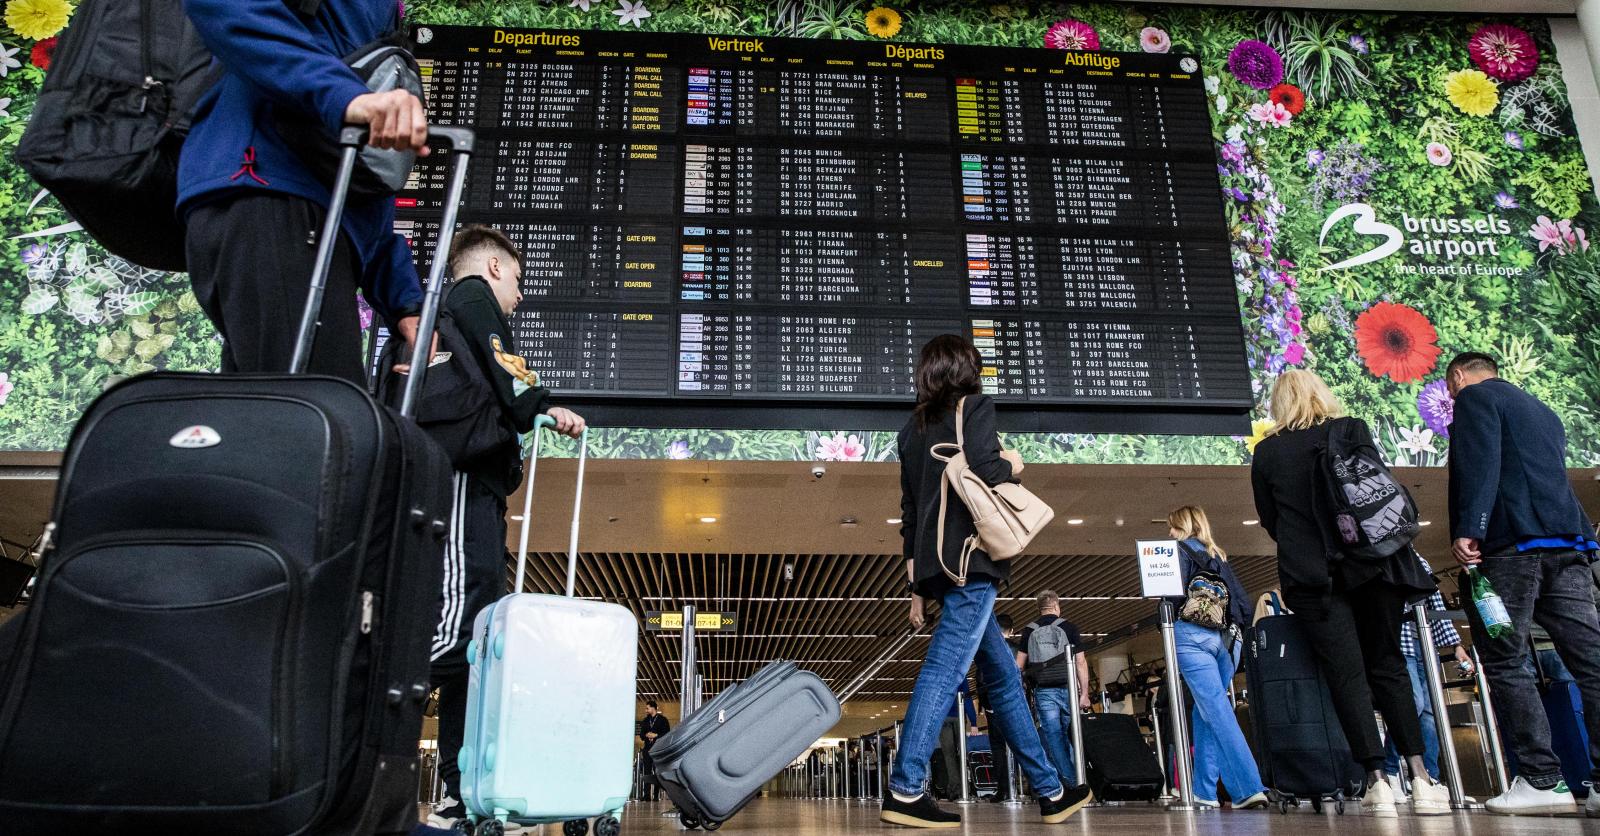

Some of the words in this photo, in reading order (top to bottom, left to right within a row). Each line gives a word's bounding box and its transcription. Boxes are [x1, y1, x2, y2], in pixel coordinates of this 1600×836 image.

[494, 29, 580, 46] Departures
[709, 37, 763, 52] Vertrek
[886, 43, 945, 61] Départs
[1065, 53, 1120, 69] Abflüge
[1402, 212, 1510, 235] brussels
[1409, 234, 1499, 260] airport
[1395, 264, 1416, 274] the
[1420, 265, 1456, 275] heart
[1459, 264, 1472, 276] of
[1476, 265, 1521, 278] Europe
[1355, 484, 1395, 507] adidas
